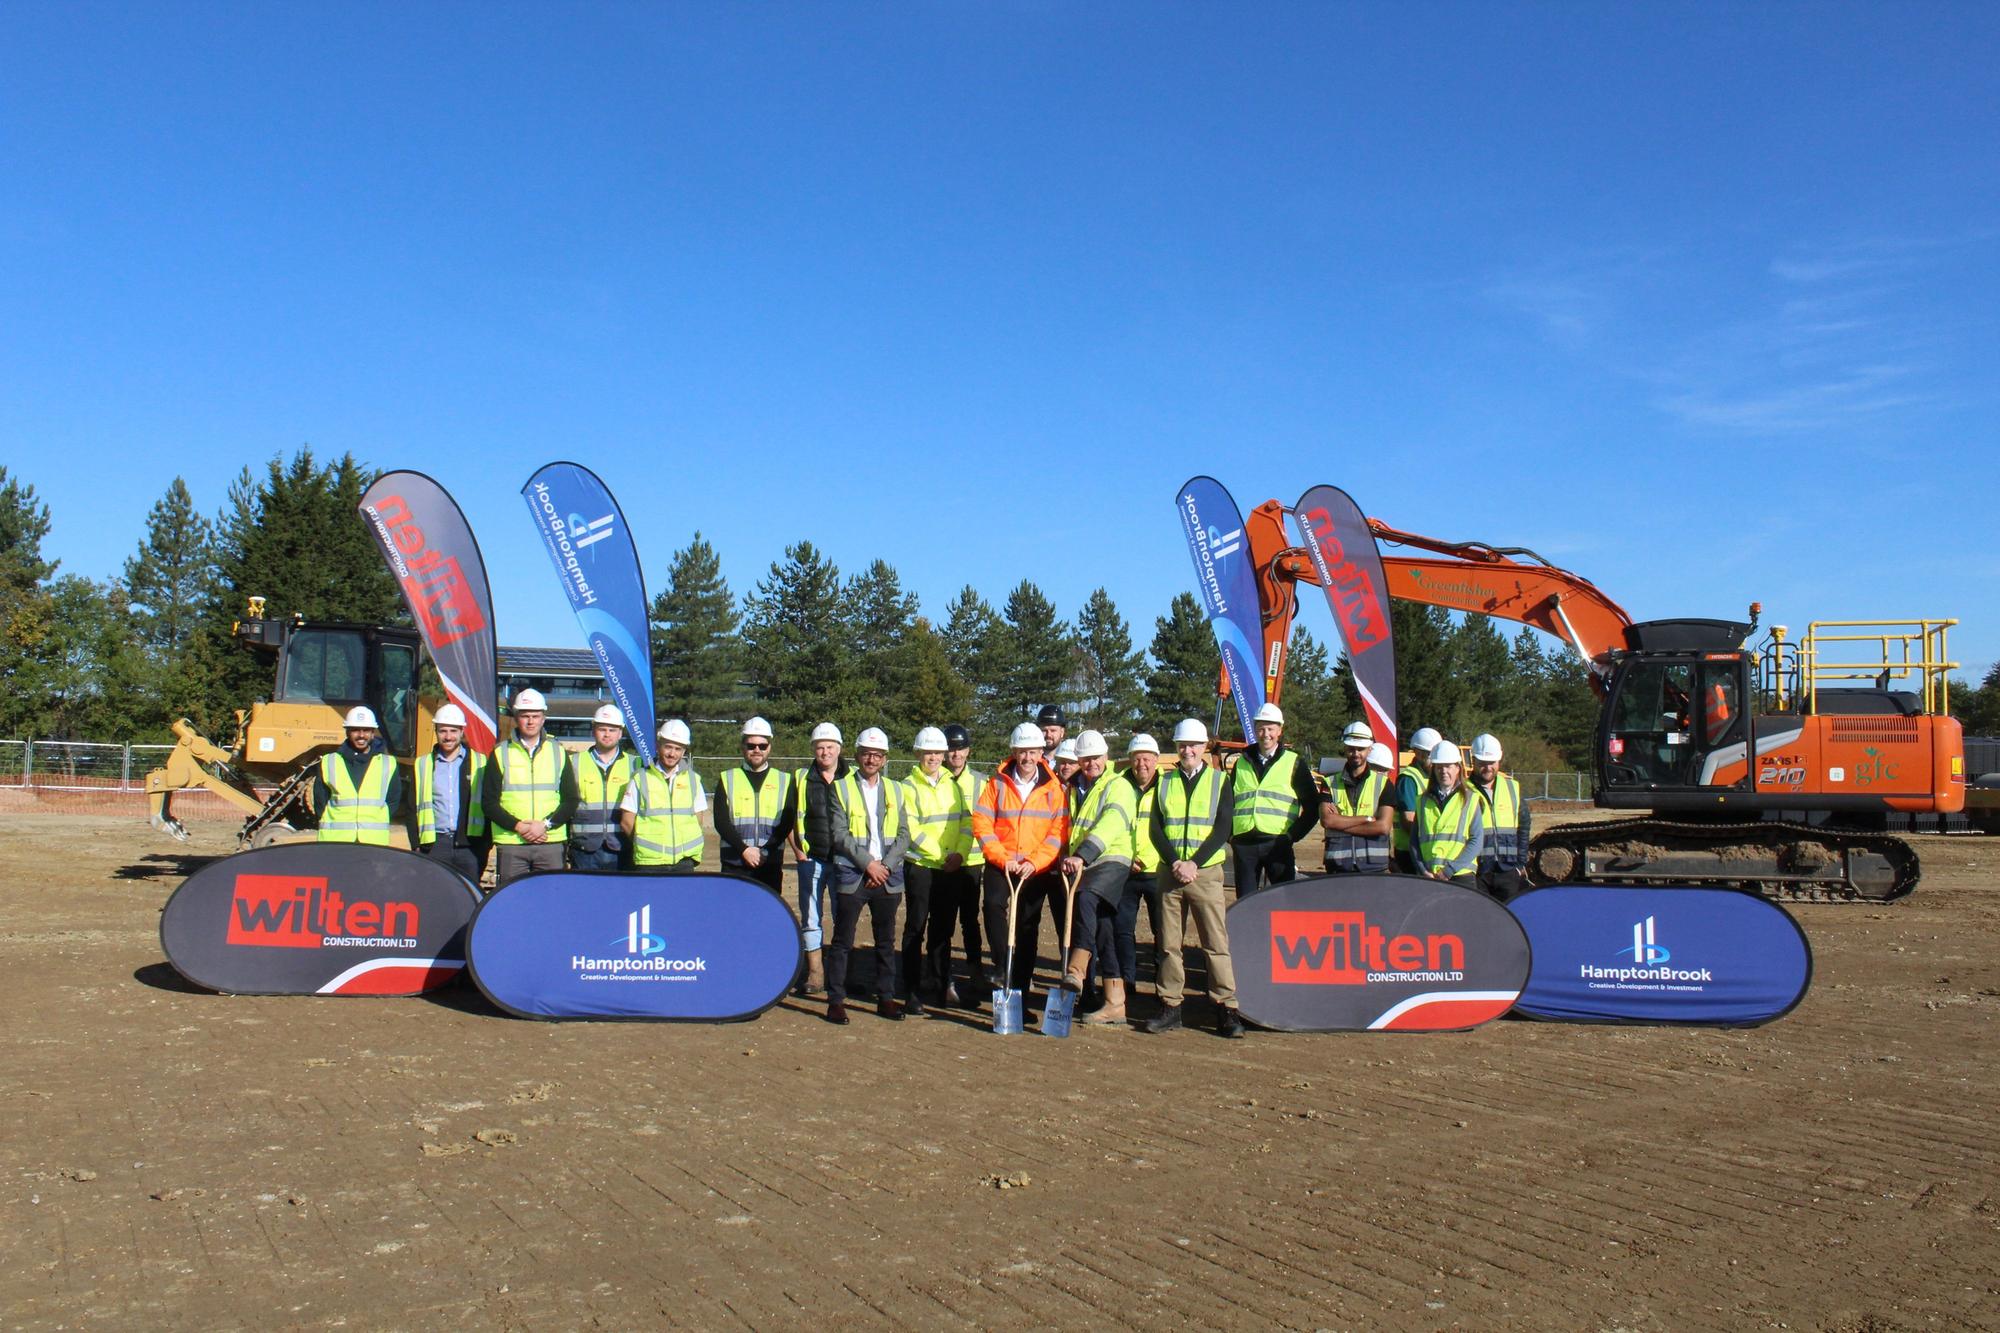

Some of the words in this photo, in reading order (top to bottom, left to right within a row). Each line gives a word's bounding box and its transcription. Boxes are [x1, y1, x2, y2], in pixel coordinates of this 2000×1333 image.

[1758, 767, 1807, 785] 210
[1855, 752, 1900, 787] gfc
[233, 886, 419, 937] wilten
[322, 937, 398, 948] CONSTRUCTION
[398, 938, 417, 948] LTD
[1273, 922, 1465, 972] wilten
[572, 955, 706, 973] HamptonBrook
[580, 973, 608, 981] Creative
[609, 974, 653, 982] Development
[1367, 971, 1444, 982] CONSTRUCTION
[1445, 971, 1464, 981] LTD
[1580, 965, 1712, 982] HamptonBrook
[1616, 983, 1660, 991] Development
[1667, 984, 1703, 992] Investment
